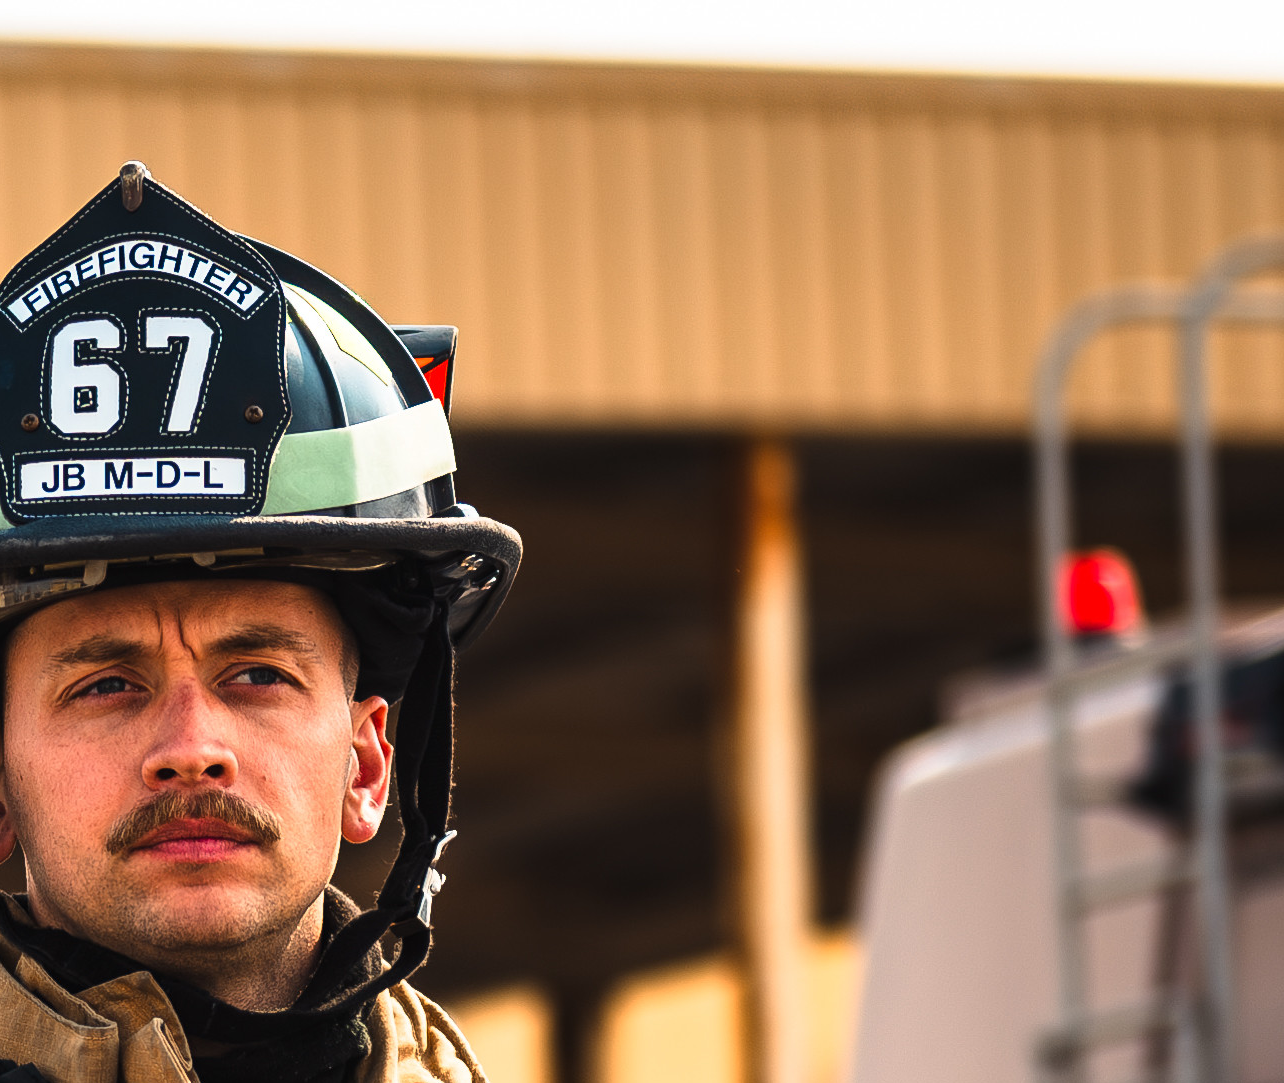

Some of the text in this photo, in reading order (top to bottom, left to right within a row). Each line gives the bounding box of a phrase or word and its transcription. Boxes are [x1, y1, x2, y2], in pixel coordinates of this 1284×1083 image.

[22, 242, 253, 313] FIREFIGHTER
[51, 316, 215, 433] 67
[42, 460, 224, 492] JB M-D-L
